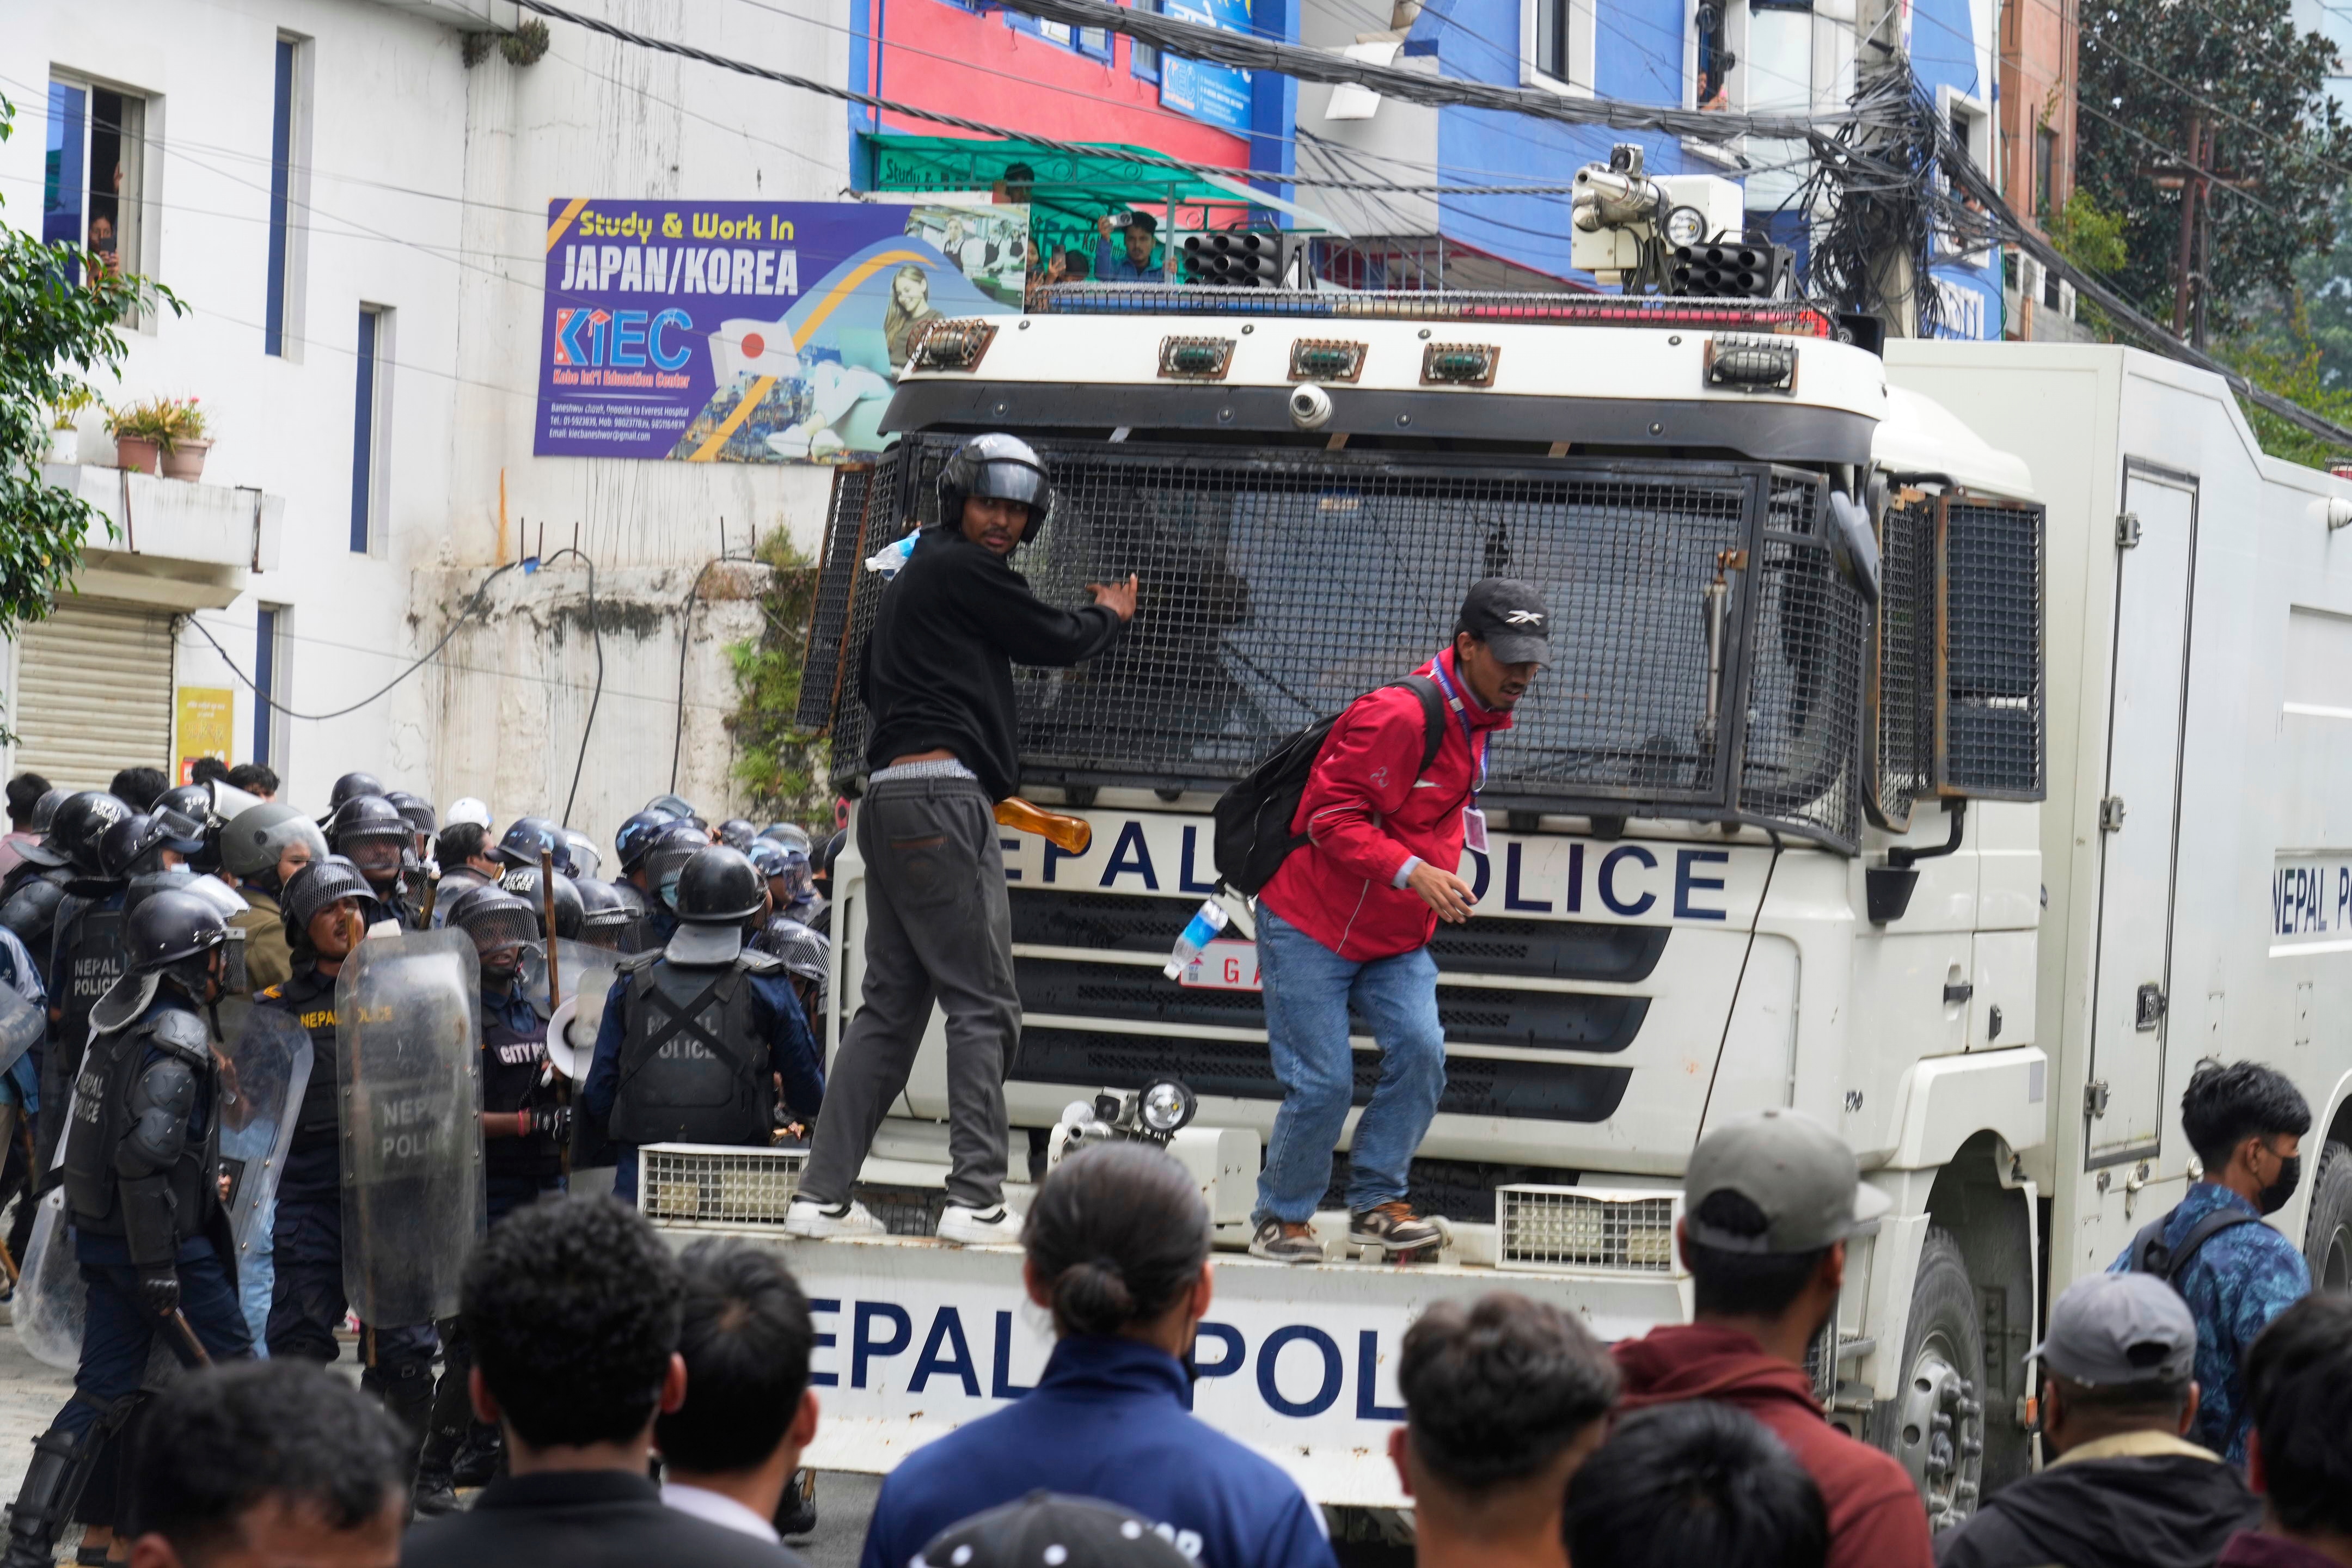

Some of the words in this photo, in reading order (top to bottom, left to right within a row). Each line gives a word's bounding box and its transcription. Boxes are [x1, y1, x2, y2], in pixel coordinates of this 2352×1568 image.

[579, 210, 653, 245] Study
[661, 213, 683, 238] &
[693, 213, 762, 240] Work
[770, 214, 794, 241] In
[560, 244, 798, 296] JAPAN/KOREA
[553, 368, 579, 385] Kobe
[603, 370, 654, 388] Education
[655, 371, 690, 389] Center
[641, 405, 663, 416] Everest
[664, 406, 689, 418] Hospital
[2273, 867, 2327, 936] NEPAL
[75, 957, 121, 977] NEPAL
[500, 1042, 531, 1064] CITY
[809, 1297, 1036, 1400] EPAL
